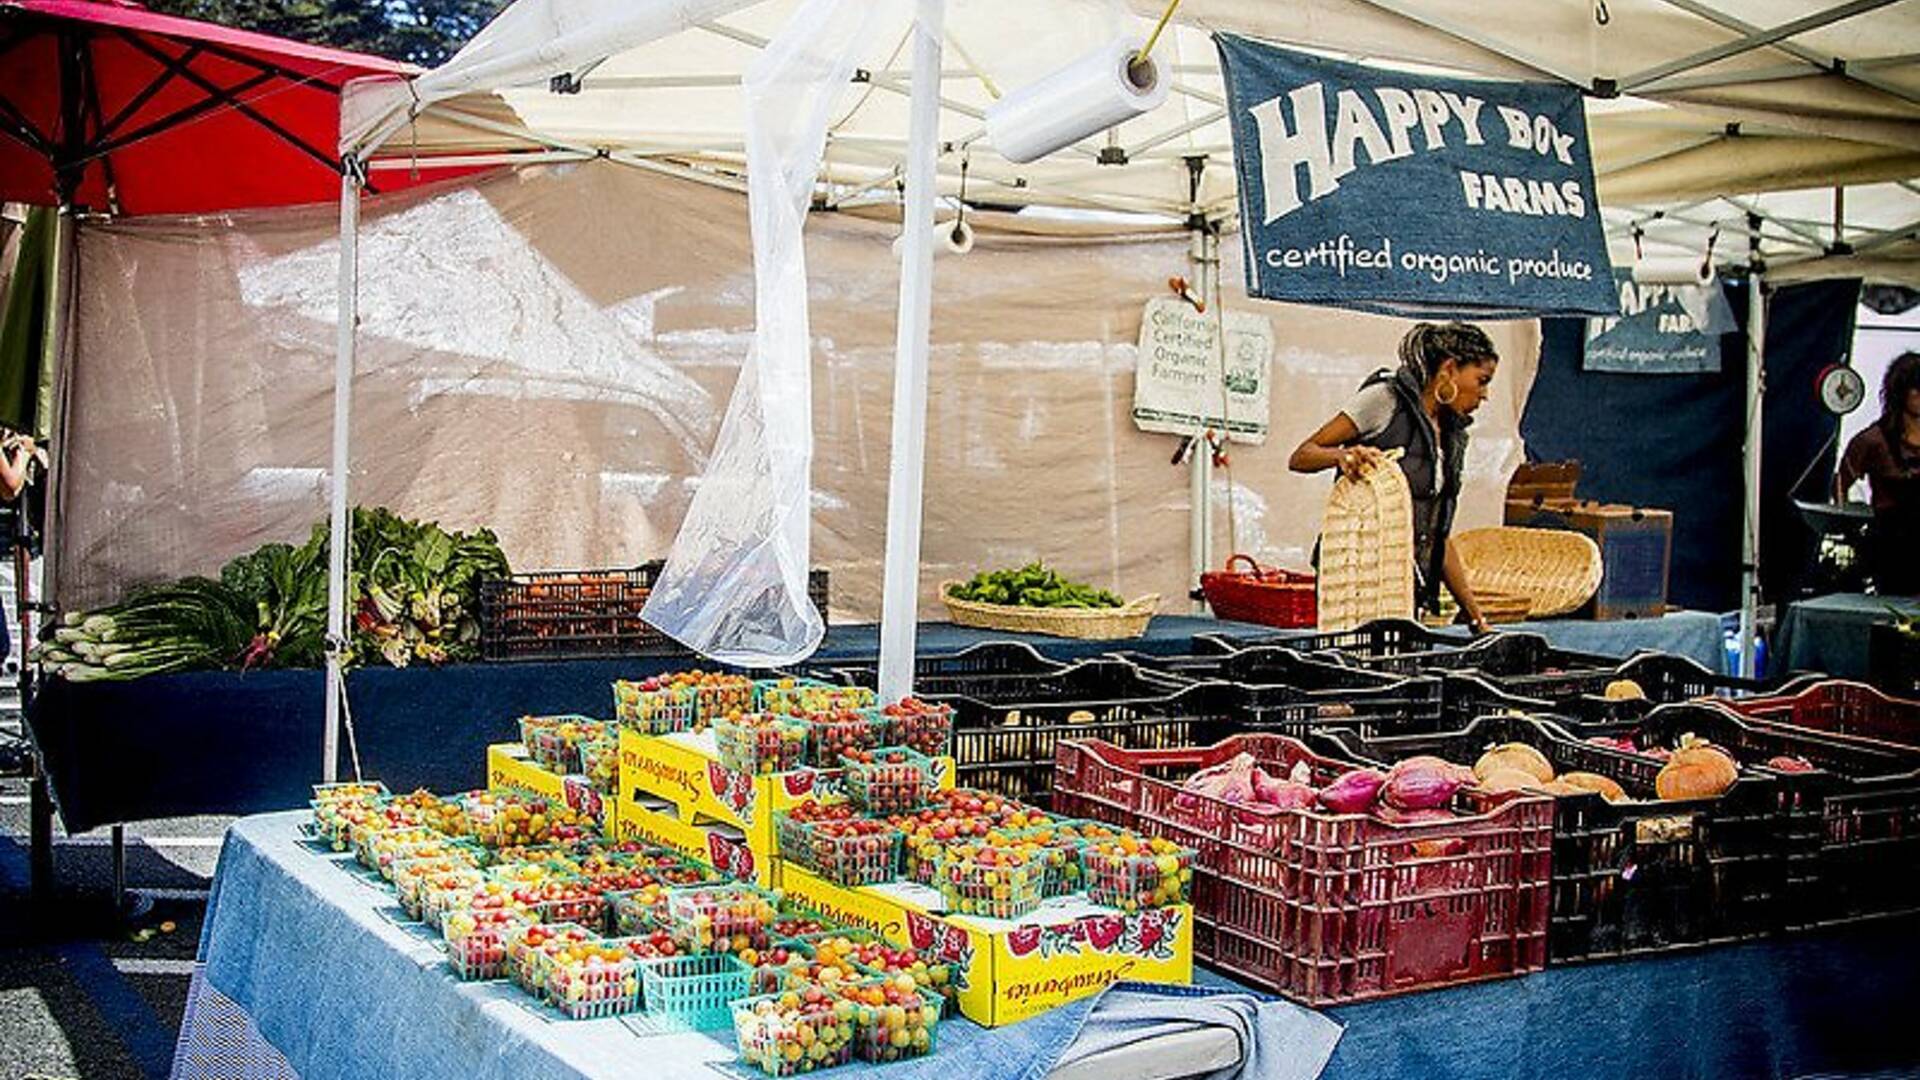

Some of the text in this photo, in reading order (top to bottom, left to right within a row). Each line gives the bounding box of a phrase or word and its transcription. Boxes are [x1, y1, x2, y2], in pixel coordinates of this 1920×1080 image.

[1248, 82, 1576, 226] HAPPY BOY
[1460, 171, 1586, 219] FARMS
[1266, 234, 1593, 285] certified organic produce
[1153, 329, 1213, 349] Certified
[1154, 345, 1208, 367] Organic
[1152, 363, 1207, 385] Farmers
